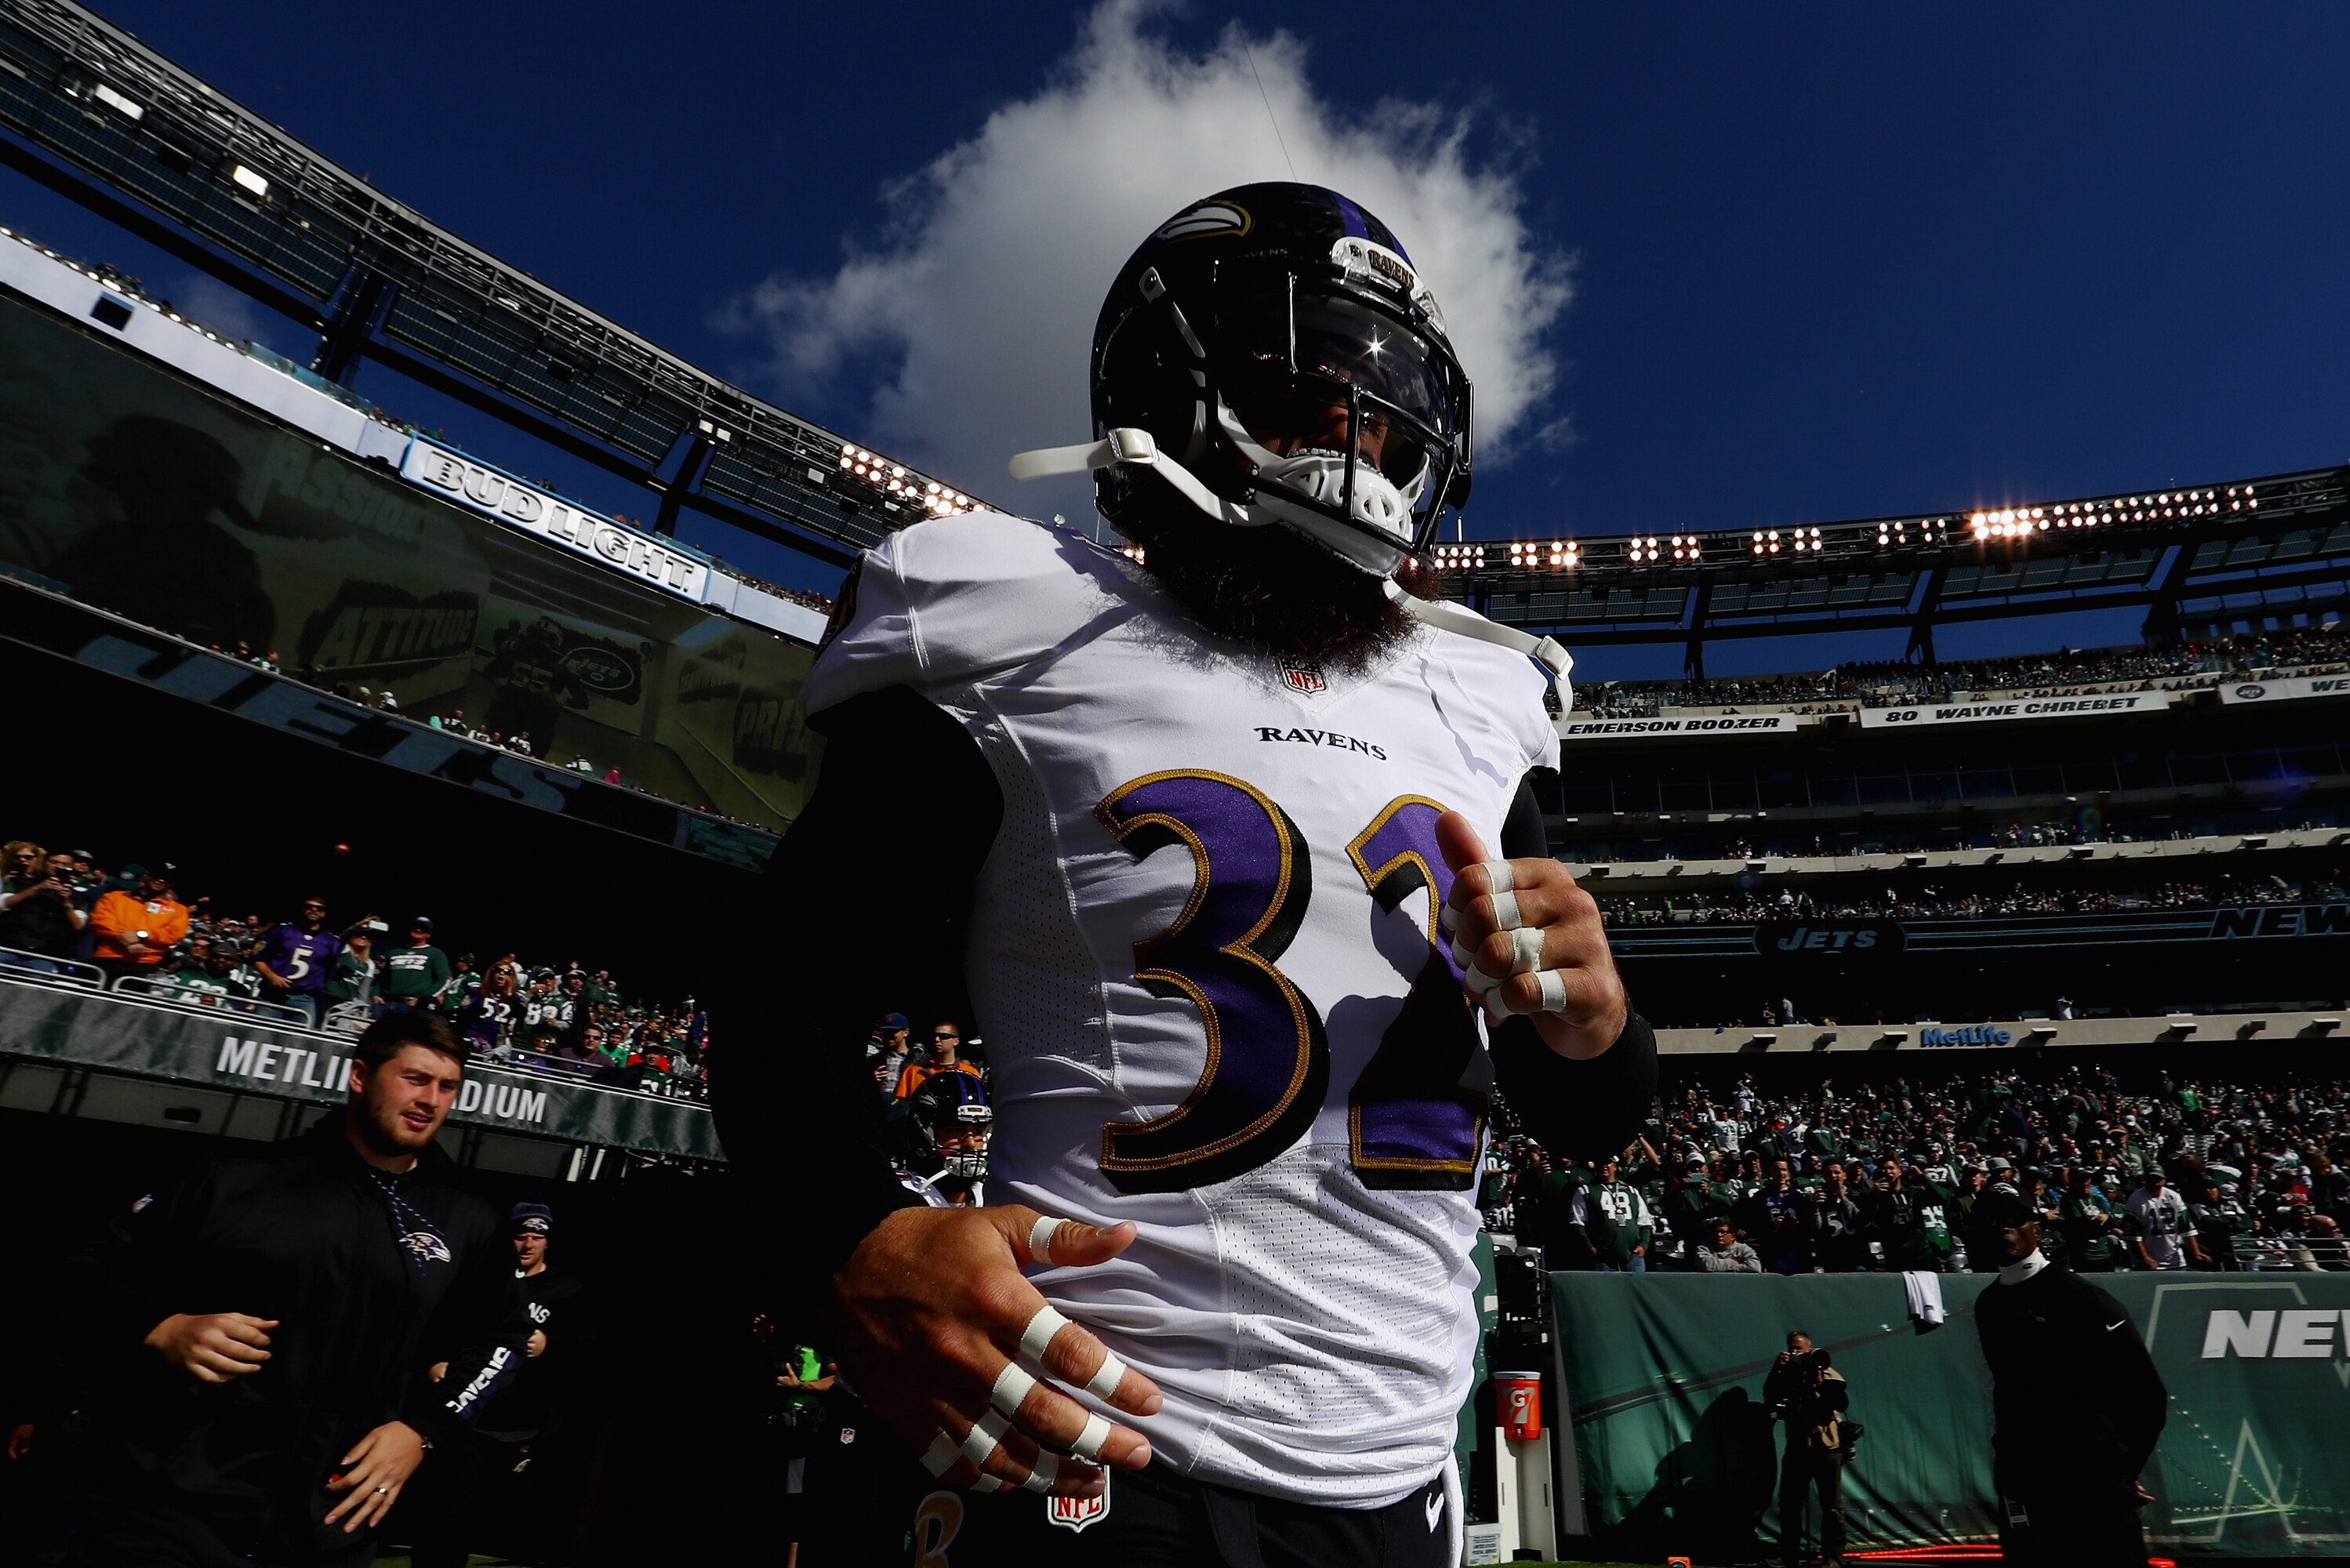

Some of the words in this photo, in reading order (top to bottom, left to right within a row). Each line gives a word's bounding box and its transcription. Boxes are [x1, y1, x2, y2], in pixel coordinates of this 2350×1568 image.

[1368, 249, 1415, 289] RAVENS
[423, 450, 543, 523] BUD
[309, 606, 477, 668] ATTITUDE
[1287, 670, 1324, 691] NFL
[1567, 720, 1680, 735] EMERSON
[1685, 717, 1780, 731] BOOZER
[1885, 710, 1918, 722] 80
[1935, 705, 2018, 720] WAYNE
[2025, 697, 2140, 714] CHREBET
[1253, 727, 1387, 760] RAVENS
[1775, 927, 1879, 951] JETS
[286, 944, 314, 980] 5
[1092, 768, 1491, 1193] 32
[478, 996, 512, 1024] 52
[1921, 1025, 2010, 1047] MetLife
[216, 1036, 353, 1093] METLI
[449, 1078, 547, 1123] DIUM
[2201, 1308, 2350, 1359] NE
[1510, 1389, 1526, 1407] G
